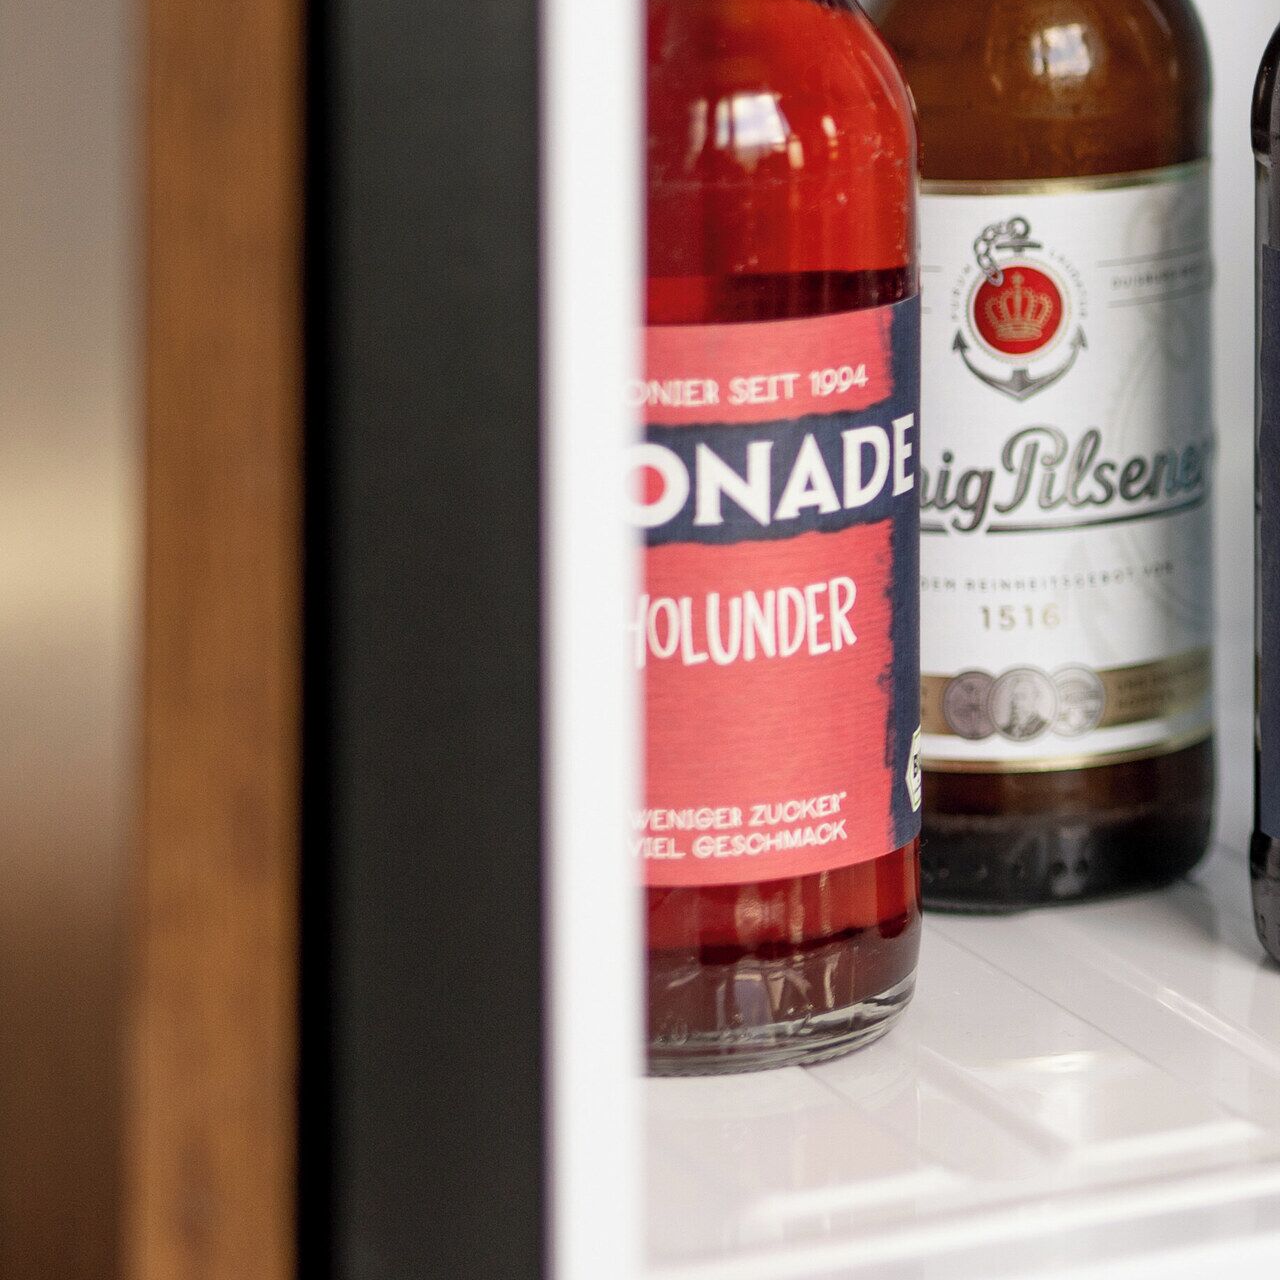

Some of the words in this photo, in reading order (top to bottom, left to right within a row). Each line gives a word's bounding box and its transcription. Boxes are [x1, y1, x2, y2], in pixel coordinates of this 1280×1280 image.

[729, 372, 801, 405] SEIT
[809, 363, 869, 397] 1994
[980, 603, 1062, 632] 1516
[692, 819, 848, 859] GESCHMACK
